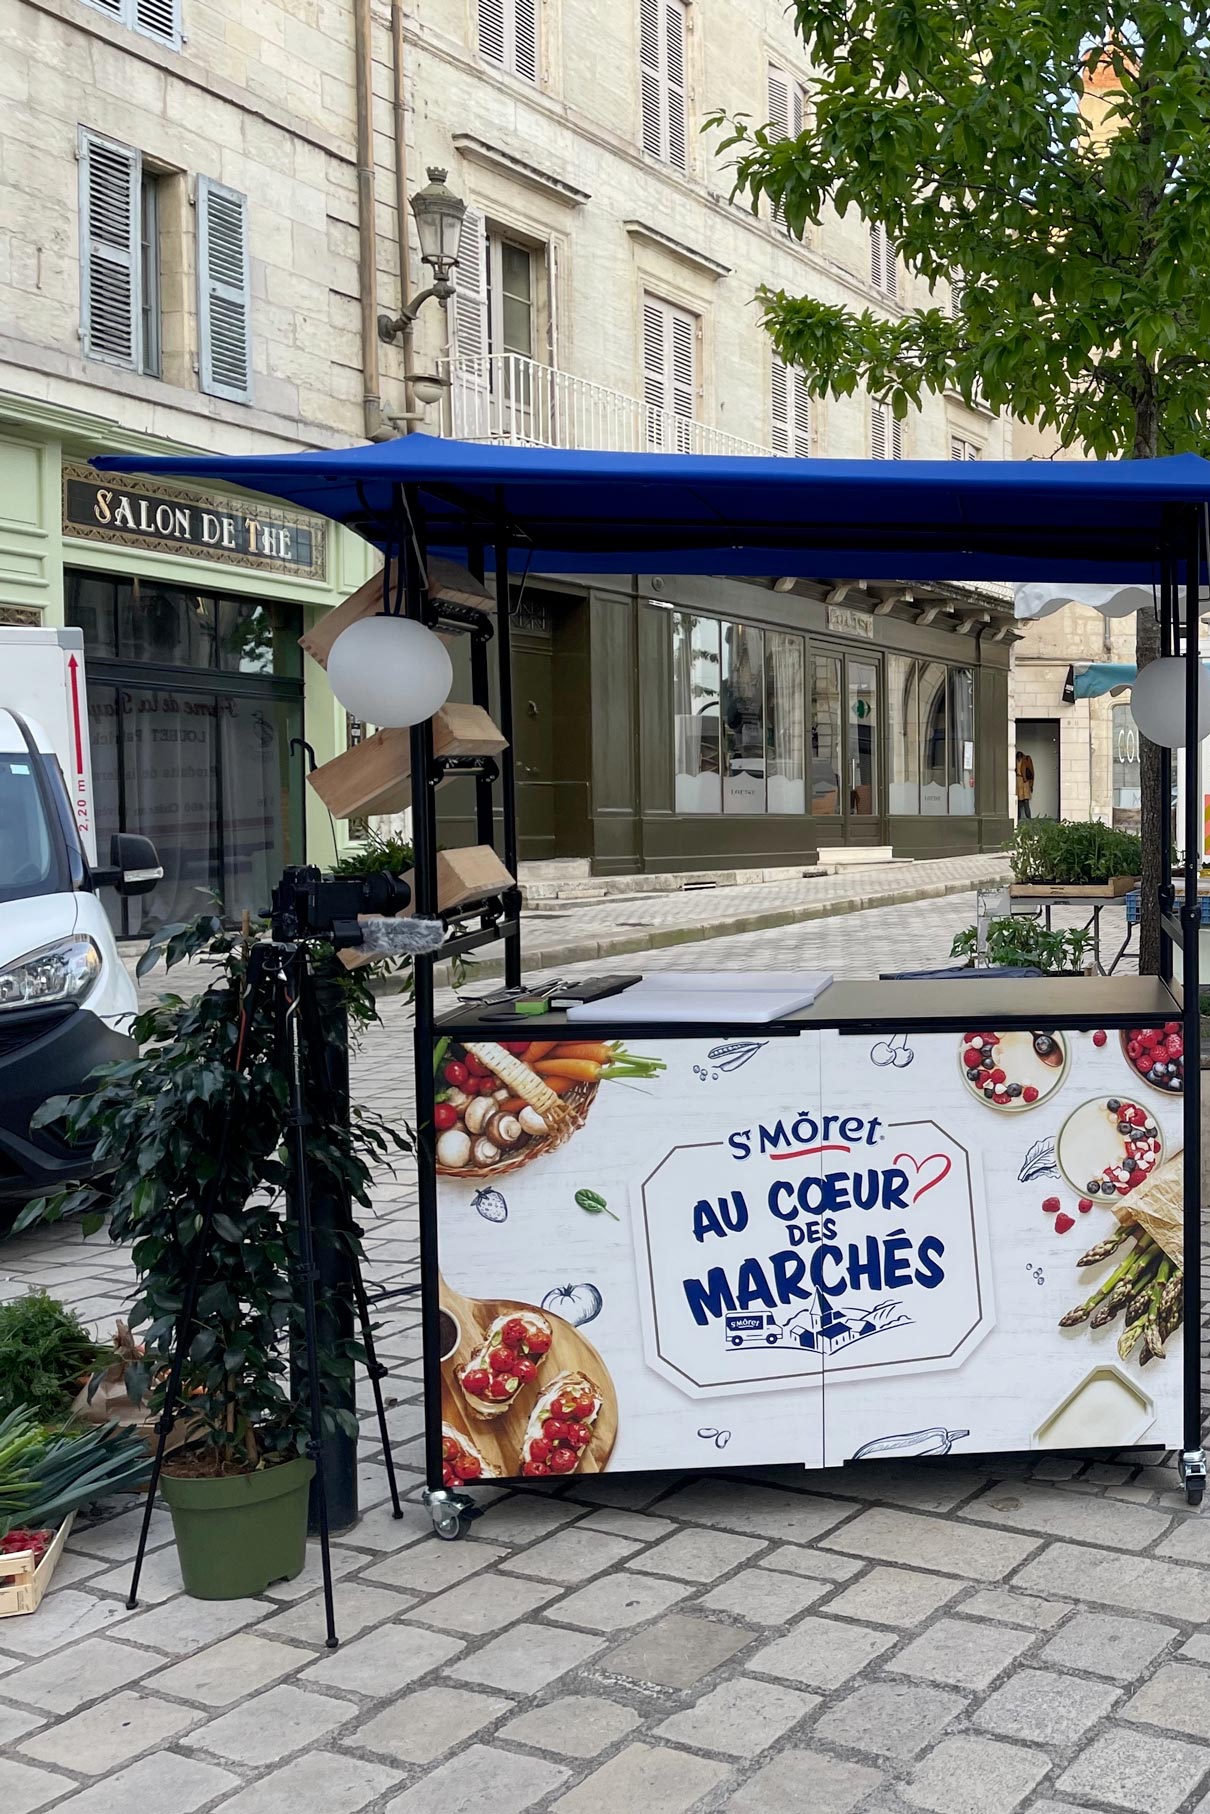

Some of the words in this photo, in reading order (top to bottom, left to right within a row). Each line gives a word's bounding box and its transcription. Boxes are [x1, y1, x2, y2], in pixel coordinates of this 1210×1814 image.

[94, 489, 192, 539] SALON
[202, 512, 236, 549] DE
[78, 779, 86, 791] m
[77, 799, 89, 832] 2,20
[758, 1110, 882, 1154] Môret
[693, 1190, 748, 1243] AU
[768, 1168, 910, 1222] CŒUR
[785, 1217, 837, 1247] DES
[682, 1228, 945, 1326] MARCHÉS
